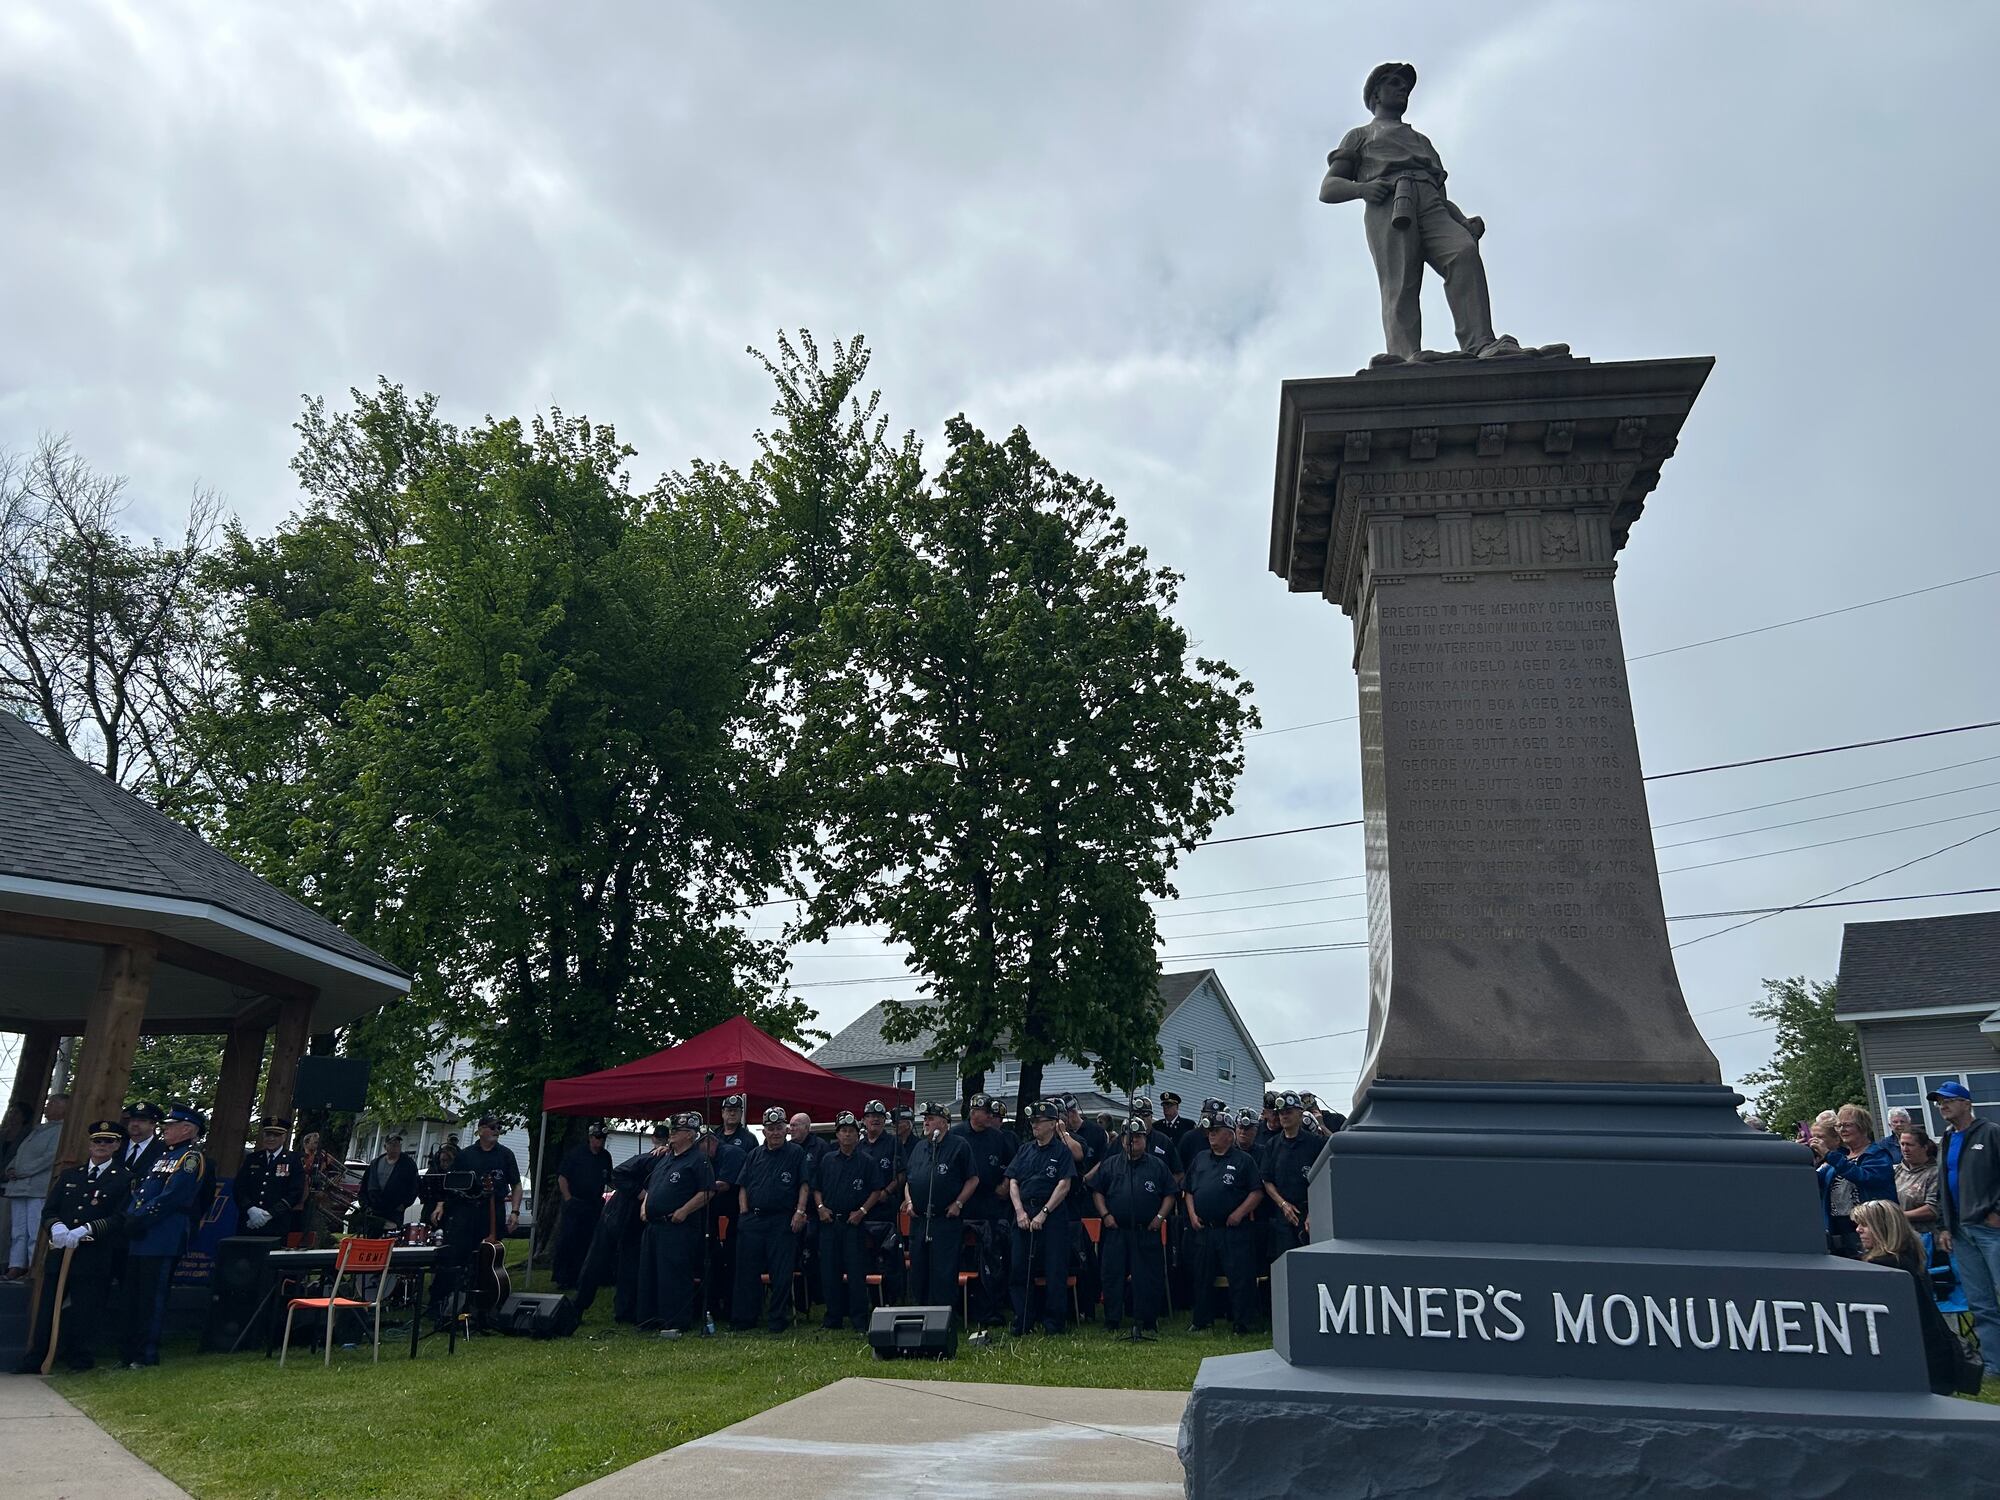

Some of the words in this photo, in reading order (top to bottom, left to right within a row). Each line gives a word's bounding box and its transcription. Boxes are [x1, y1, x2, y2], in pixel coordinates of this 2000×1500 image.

[1381, 605, 1438, 619] ERECTED
[1441, 604, 1457, 617] TO
[1461, 603, 1487, 617] THE
[1491, 601, 1544, 616] MEMORY
[1549, 601, 1565, 614] OF
[1568, 600, 1612, 613] THOSE
[1381, 624, 1420, 638] KILLED
[1424, 624, 1435, 636] IN
[1439, 622, 1503, 636] EXPLOSION
[1507, 621, 1518, 634] IN
[1557, 619, 1616, 632] COLLIERY
[1392, 643, 1420, 656] NEW
[1425, 641, 1503, 655] WATERFORD
[1507, 640, 1538, 652] JULY
[1389, 661, 1444, 674] GAETON
[1452, 660, 1506, 673] ANGELO
[1513, 659, 1551, 671] AGED
[1559, 658, 1578, 671] 24
[1584, 657, 1617, 670] YRS.
[1388, 681, 1434, 693] FRANK
[1518, 678, 1554, 690] AGED
[1563, 677, 1583, 689] 32
[1589, 676, 1622, 689] YRS.
[1391, 699, 1481, 712] CONSTANTINO
[1522, 697, 1559, 710] AGED
[1567, 696, 1586, 709] 22
[1591, 696, 1625, 709] YRS.
[1406, 719, 1449, 731] ISAAC
[1456, 718, 1503, 730] BOONE
[1510, 717, 1546, 729] AGED
[1582, 716, 1614, 729] YRS.
[1408, 738, 1464, 751] GEORGE
[1472, 737, 1508, 750] BUTT
[1513, 736, 1549, 749] AGED
[1581, 736, 1614, 749] YRS.
[1401, 758, 1457, 771] GEORGE
[1525, 757, 1562, 769] AGED
[1591, 756, 1625, 769] YRS.
[1402, 778, 1457, 791] JOSEPH
[1528, 777, 1563, 790] AGED
[1571, 776, 1588, 789] 37
[1592, 776, 1628, 789] YRS.
[1409, 799, 1467, 812] RICHARD
[1525, 798, 1561, 810] AGED
[1569, 797, 1586, 810] 37
[1591, 797, 1626, 810] YRS.
[1398, 819, 1472, 832] ARCHIBALD
[1544, 818, 1581, 831] AGED
[1611, 817, 1643, 830] YRS.
[1317, 1283, 1526, 1342] MINER'S
[1552, 1292, 1890, 1356] MONUMENT
